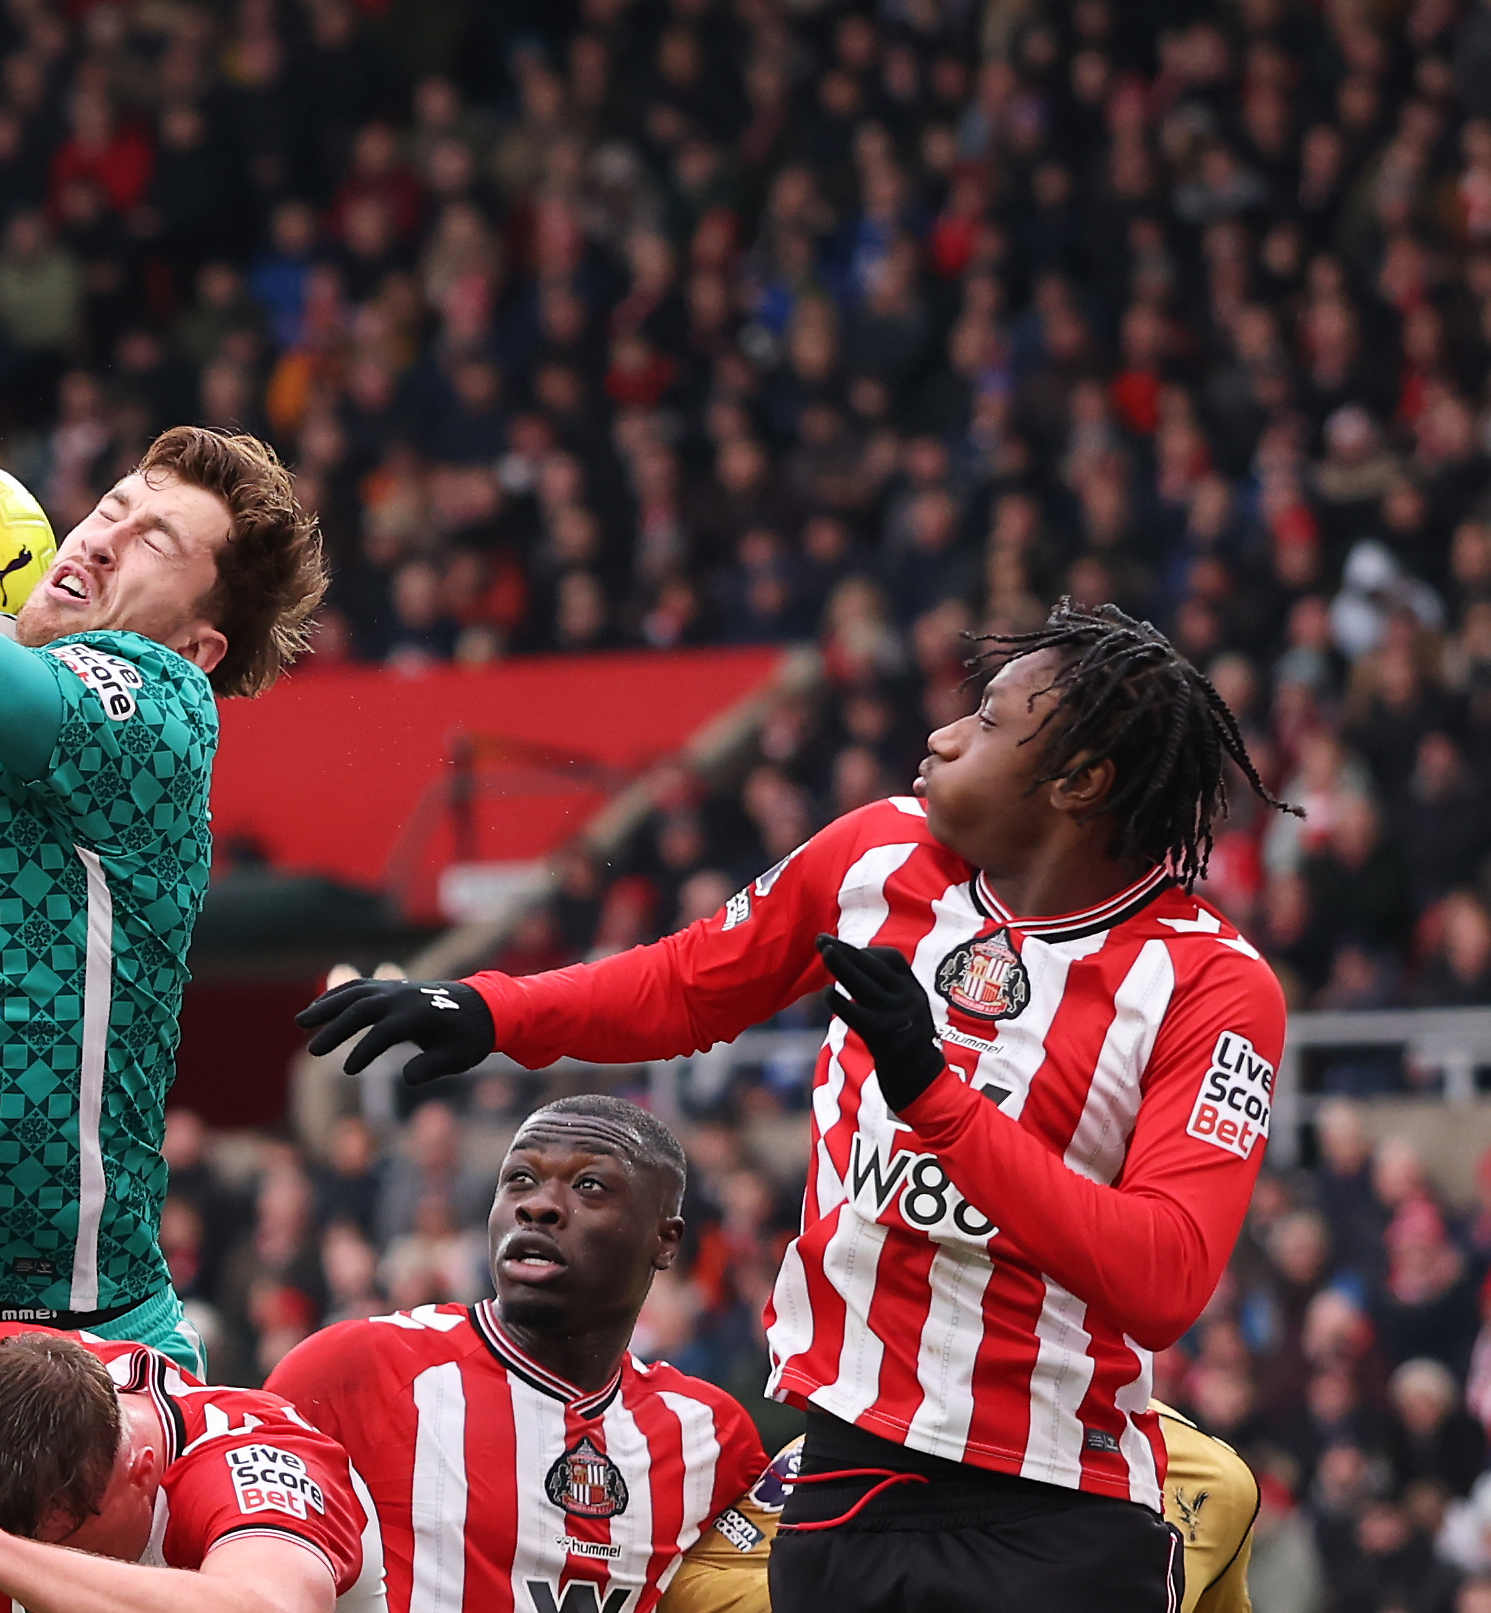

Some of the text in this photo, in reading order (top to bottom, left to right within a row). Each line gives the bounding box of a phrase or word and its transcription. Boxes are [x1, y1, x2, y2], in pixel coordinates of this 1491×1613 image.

[944, 1029, 1004, 1054] hummel
[1218, 1037, 1272, 1093] Live
[1205, 1071, 1269, 1127] Scor
[1193, 1103, 1253, 1153] Bet
[231, 1447, 301, 1470] Live
[237, 1466, 323, 1509] Score
[242, 1488, 302, 1514] Bet
[572, 1539, 622, 1557] hummel
